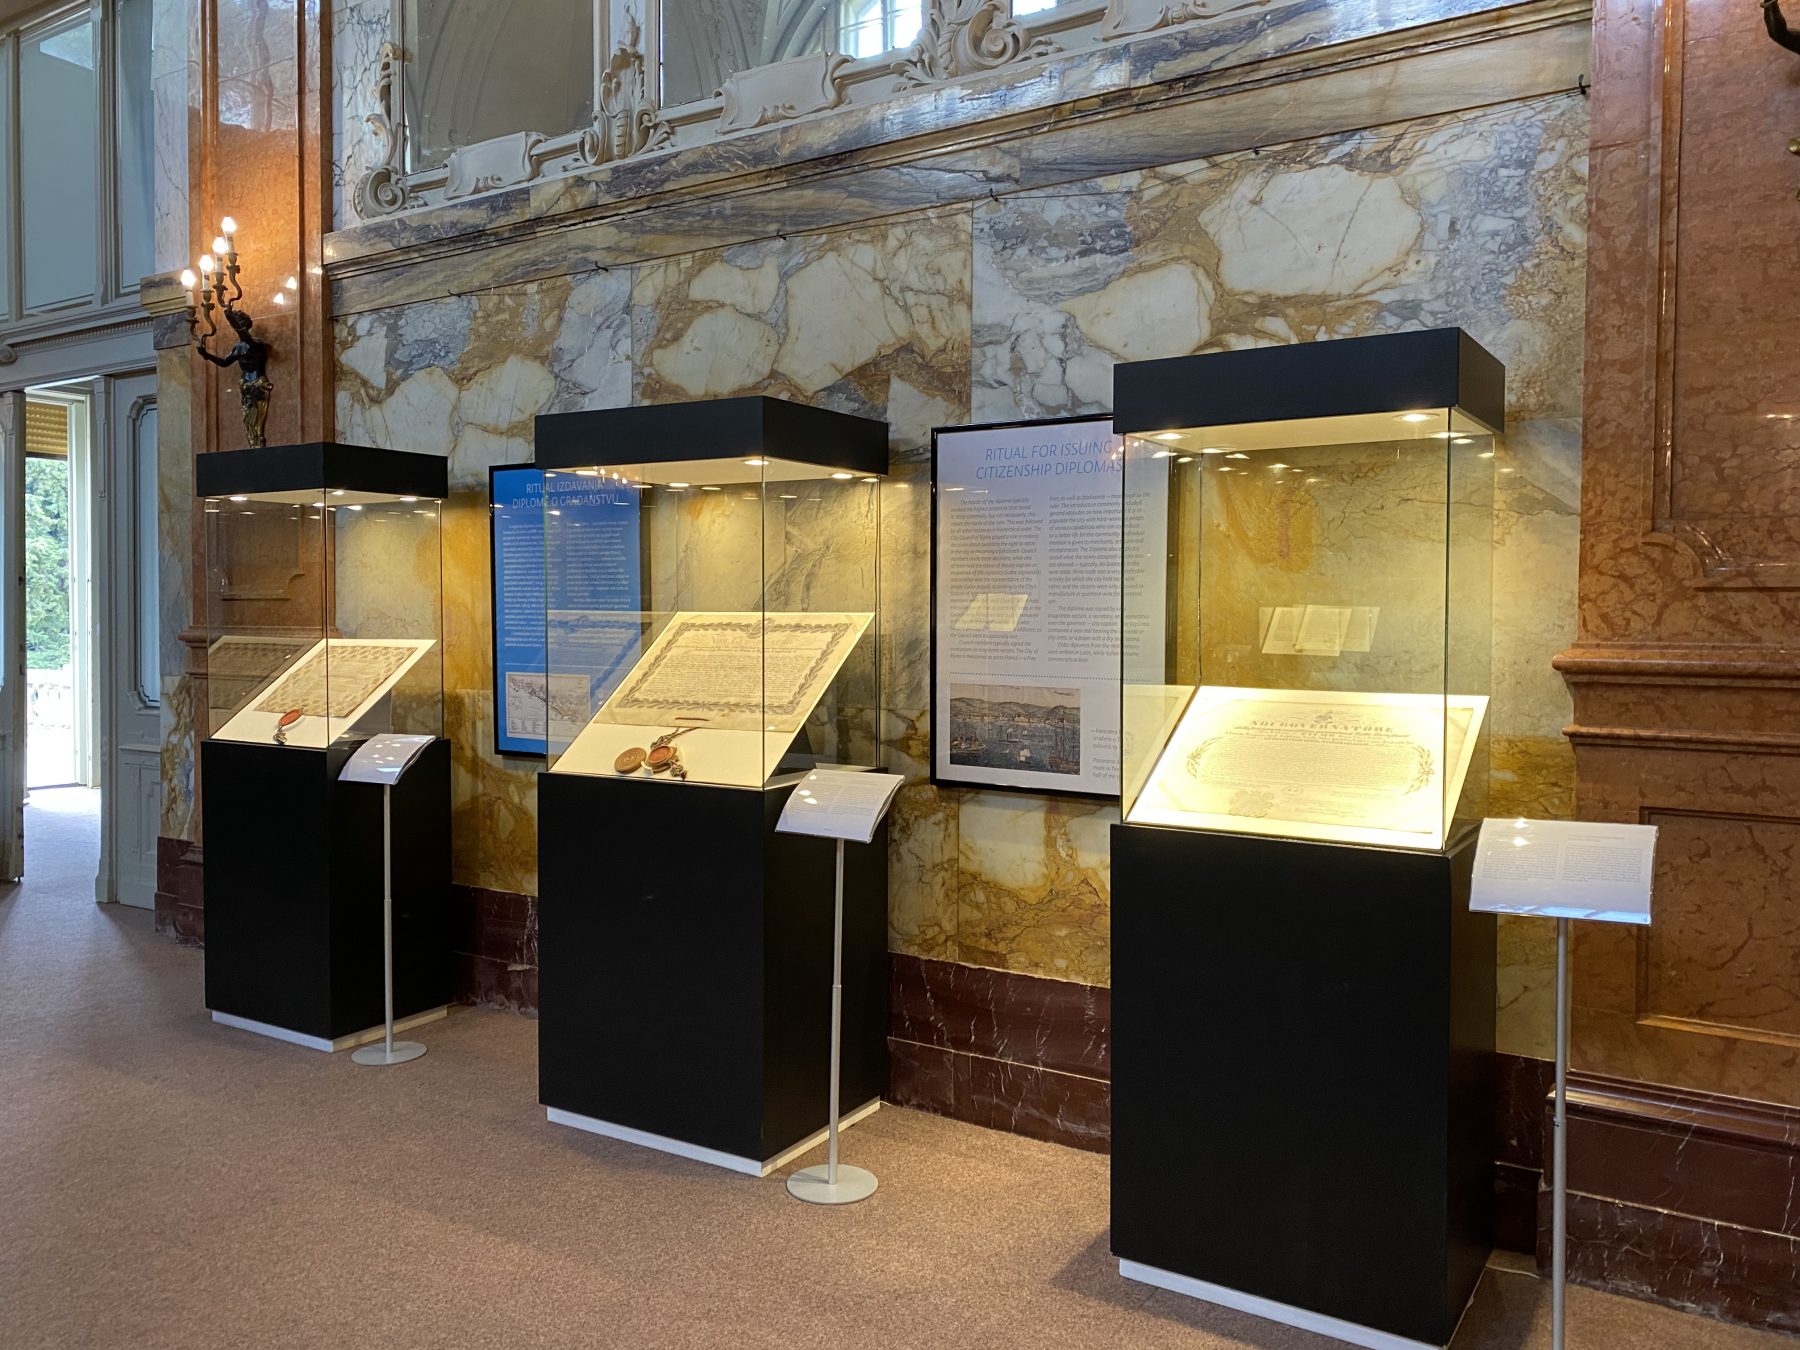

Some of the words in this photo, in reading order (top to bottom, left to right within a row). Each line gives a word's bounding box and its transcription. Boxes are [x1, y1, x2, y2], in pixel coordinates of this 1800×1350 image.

[986, 445, 1028, 461] RITUAL
[1032, 444, 1057, 458] FOR
[1060, 440, 1112, 456] ISSUING
[976, 463, 1052, 480] CITIZENSHIP
[1056, 458, 1122, 476] DIPLOMAS
[526, 482, 556, 494] RITUAL
[557, 480, 603, 492] IZDAVANJA
[552, 497, 558, 506] O
